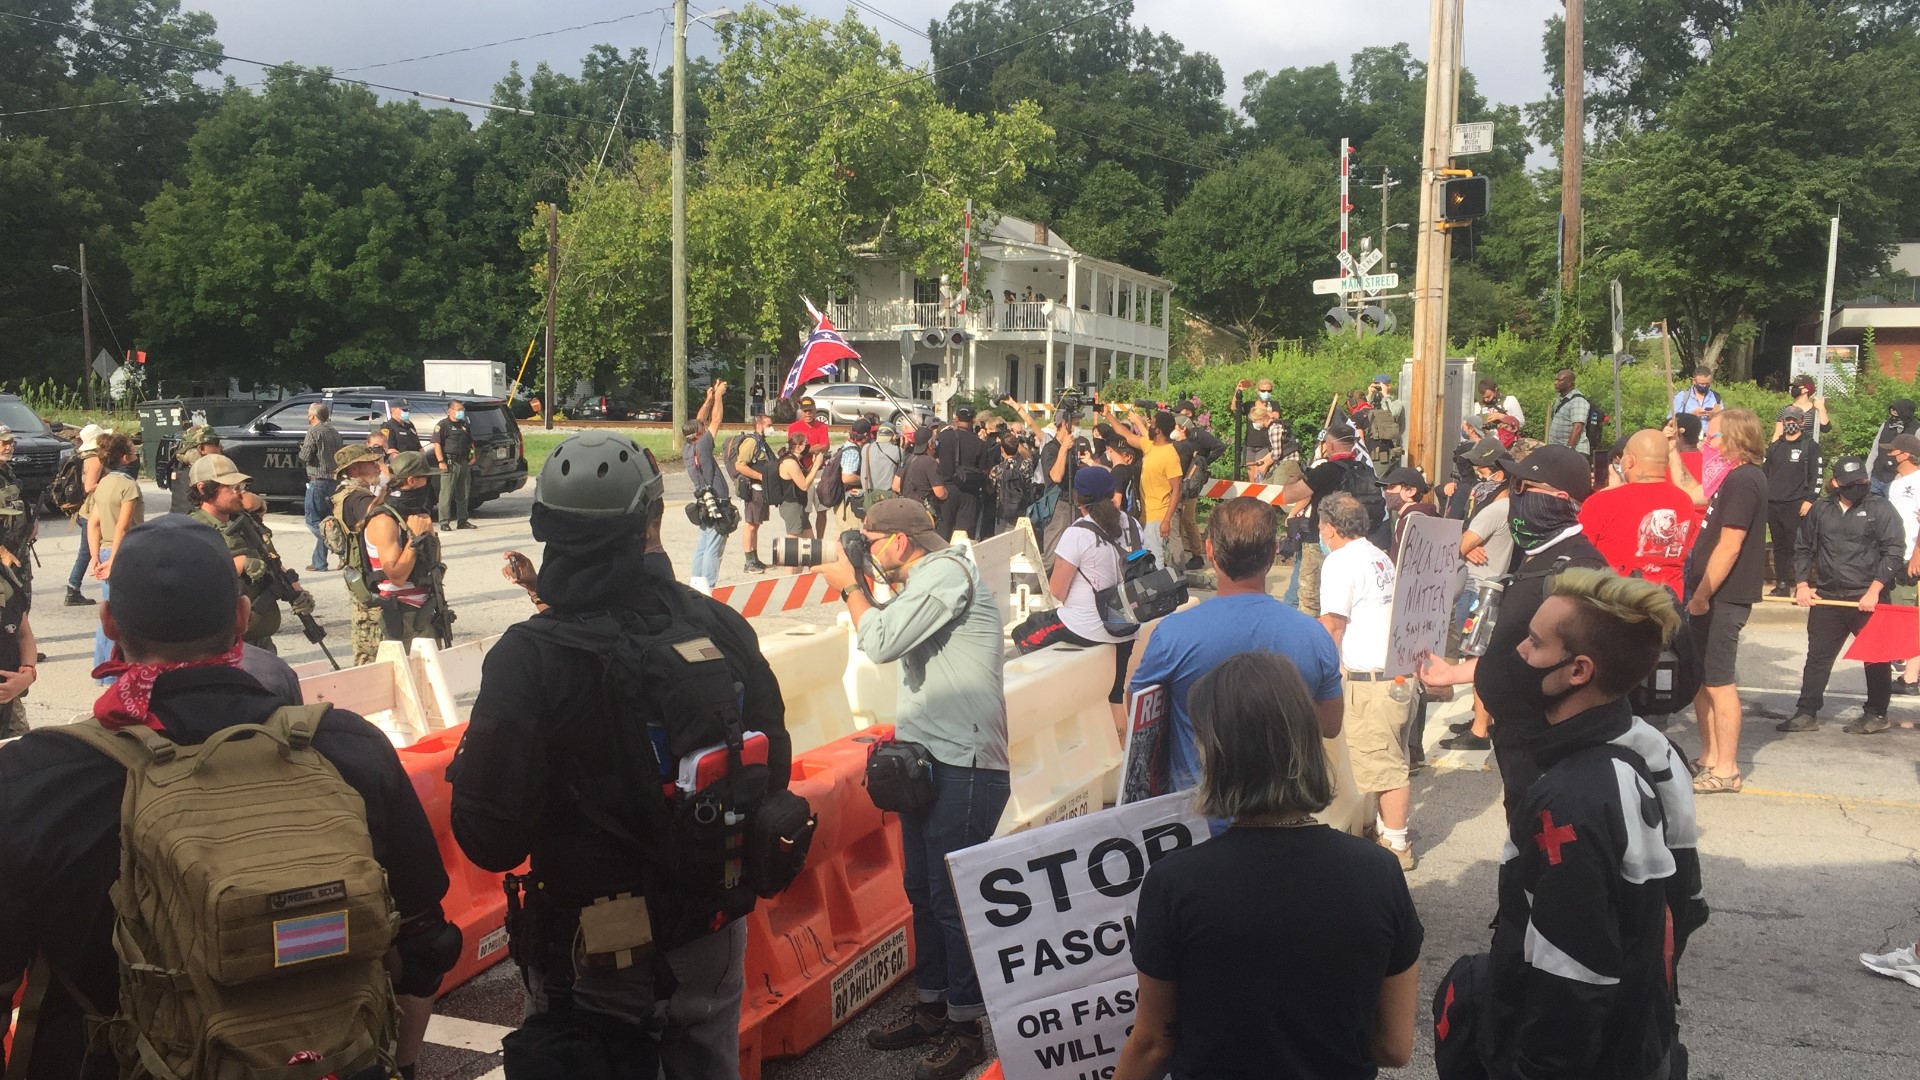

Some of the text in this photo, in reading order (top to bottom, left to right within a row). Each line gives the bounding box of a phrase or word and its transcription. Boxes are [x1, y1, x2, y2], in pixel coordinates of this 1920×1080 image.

[1463, 131, 1481, 140] MUST
[1341, 275, 1396, 290] MAIN STREET
[1403, 578, 1446, 616] MATTER
[287, 884, 345, 904] REBEL SCUM
[832, 931, 904, 992] RENTED FROM 770-939-6115
[850, 955, 889, 1008] PHILLIPS
[1017, 989, 1140, 1039] OR FAS
[1034, 1033, 1116, 1070] WILL
